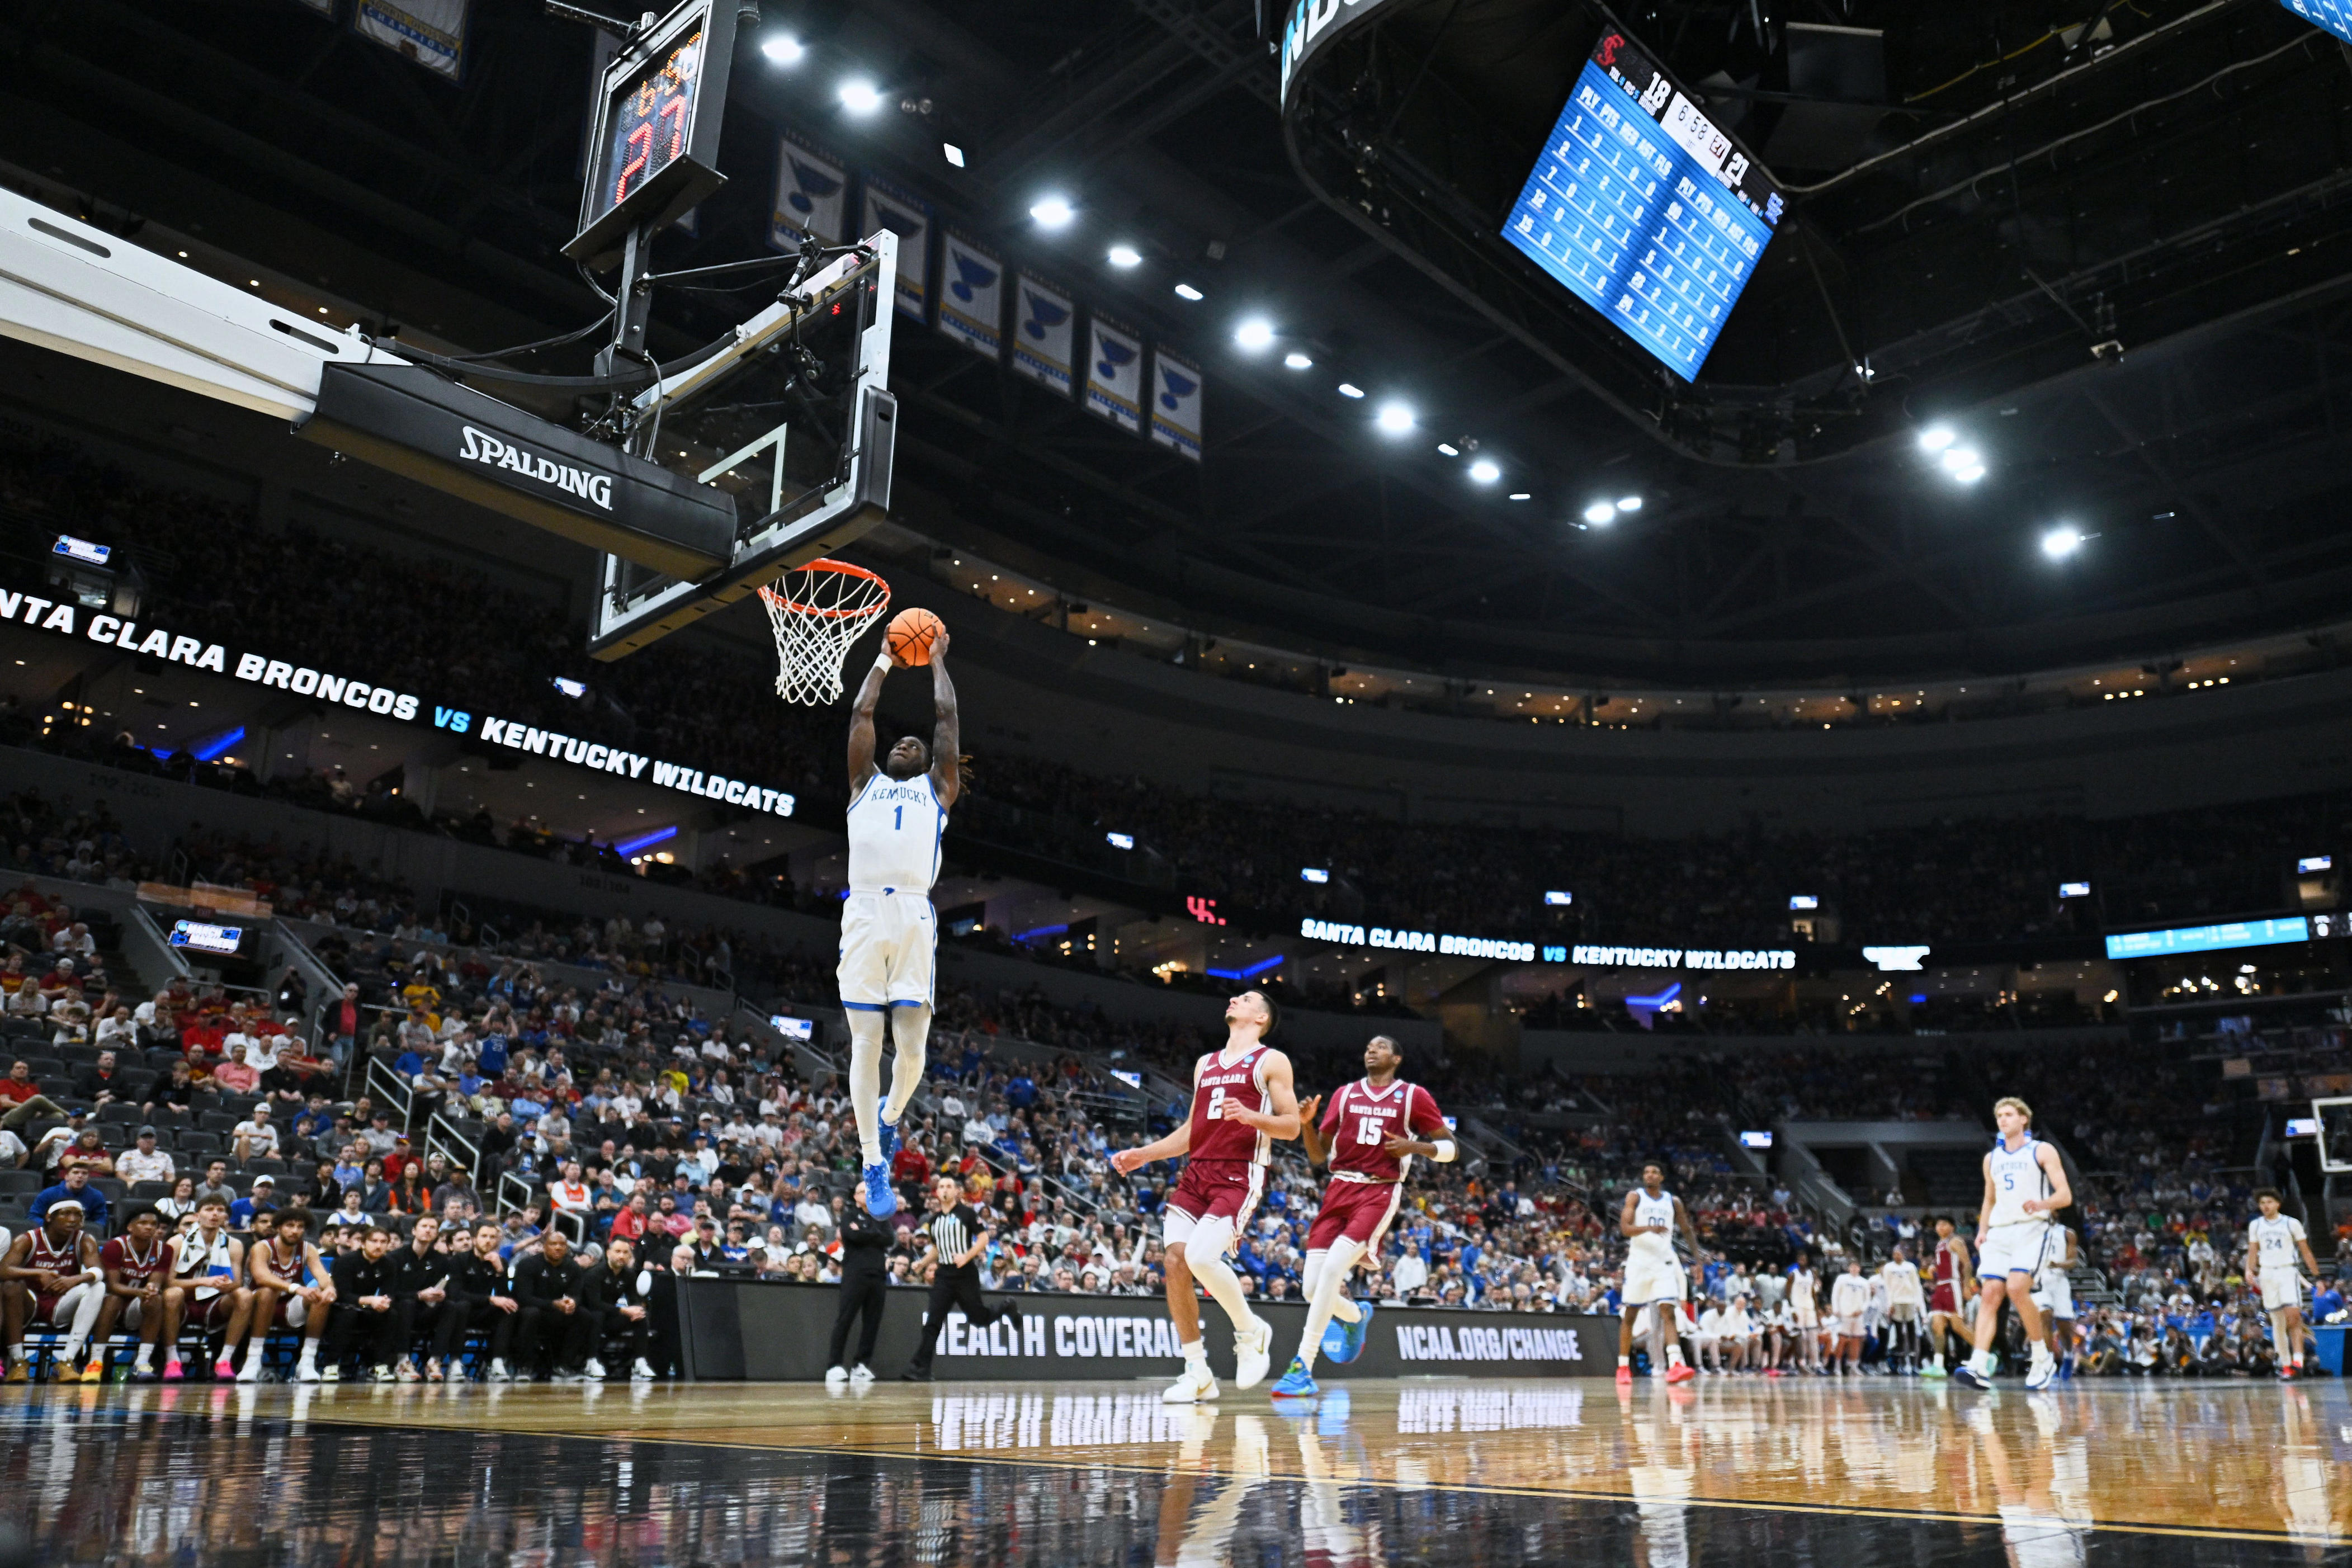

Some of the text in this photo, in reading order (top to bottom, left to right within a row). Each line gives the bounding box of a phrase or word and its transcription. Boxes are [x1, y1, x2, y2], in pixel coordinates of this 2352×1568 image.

[1618, 76, 1626, 86] 4
[1632, 89, 1640, 100] 5
[1643, 71, 1671, 109] 18
[1572, 115, 1582, 131] 1
[1612, 152, 1621, 166] 1
[1579, 86, 1673, 176] PLY PTS REB AST FLS
[1678, 105, 1708, 140] 6:58
[616, 95, 686, 204] 27
[1725, 152, 1750, 187] 21
[1558, 141, 1570, 157] 2
[1579, 158, 1590, 174] 2
[1599, 175, 1610, 191] 2
[1616, 191, 1626, 206] 1
[1547, 166, 1558, 180] 7
[1587, 200, 1596, 215] 1
[1621, 229, 1631, 244] 1
[1678, 176, 1697, 197] PLY
[1695, 192, 1714, 214] PTS
[1518, 214, 1534, 233] 15
[1561, 248, 1571, 263] 1
[1579, 262, 1589, 277] 1
[1531, 188, 1547, 209] 12
[1574, 224, 1584, 239] 1
[1609, 252, 1619, 267] 1
[1688, 218, 1698, 233] 7
[1705, 234, 1714, 248] 1
[1720, 247, 1729, 262] 1
[1645, 249, 1656, 265] 5
[1695, 292, 1705, 306] 1
[1658, 226, 1668, 242] 1
[1722, 284, 1731, 296] 1
[1671, 336, 1682, 350] 1
[1687, 348, 1697, 362] 1
[460, 425, 613, 511] SPALDING
[87, 615, 225, 673] CLARA
[235, 653, 419, 721] BRONCOS
[434, 706, 470, 733] VS
[480, 716, 649, 778] KENTUCKY
[653, 761, 795, 818] WILDCATS
[894, 805, 903, 830] 1
[1301, 918, 1796, 970] SANTA CLARA BRONCOS VS KENTUCKY WILDCATS
[1200, 1073, 1246, 1088] SANTA CLARA
[1207, 1087, 1226, 1120] 2
[1349, 1104, 1397, 1118] SANTA CLARA
[1356, 1116, 1384, 1146] 15
[2004, 1173, 2014, 1191] 5
[1396, 1325, 1583, 1361] NCAA.ORG/CHANGE
